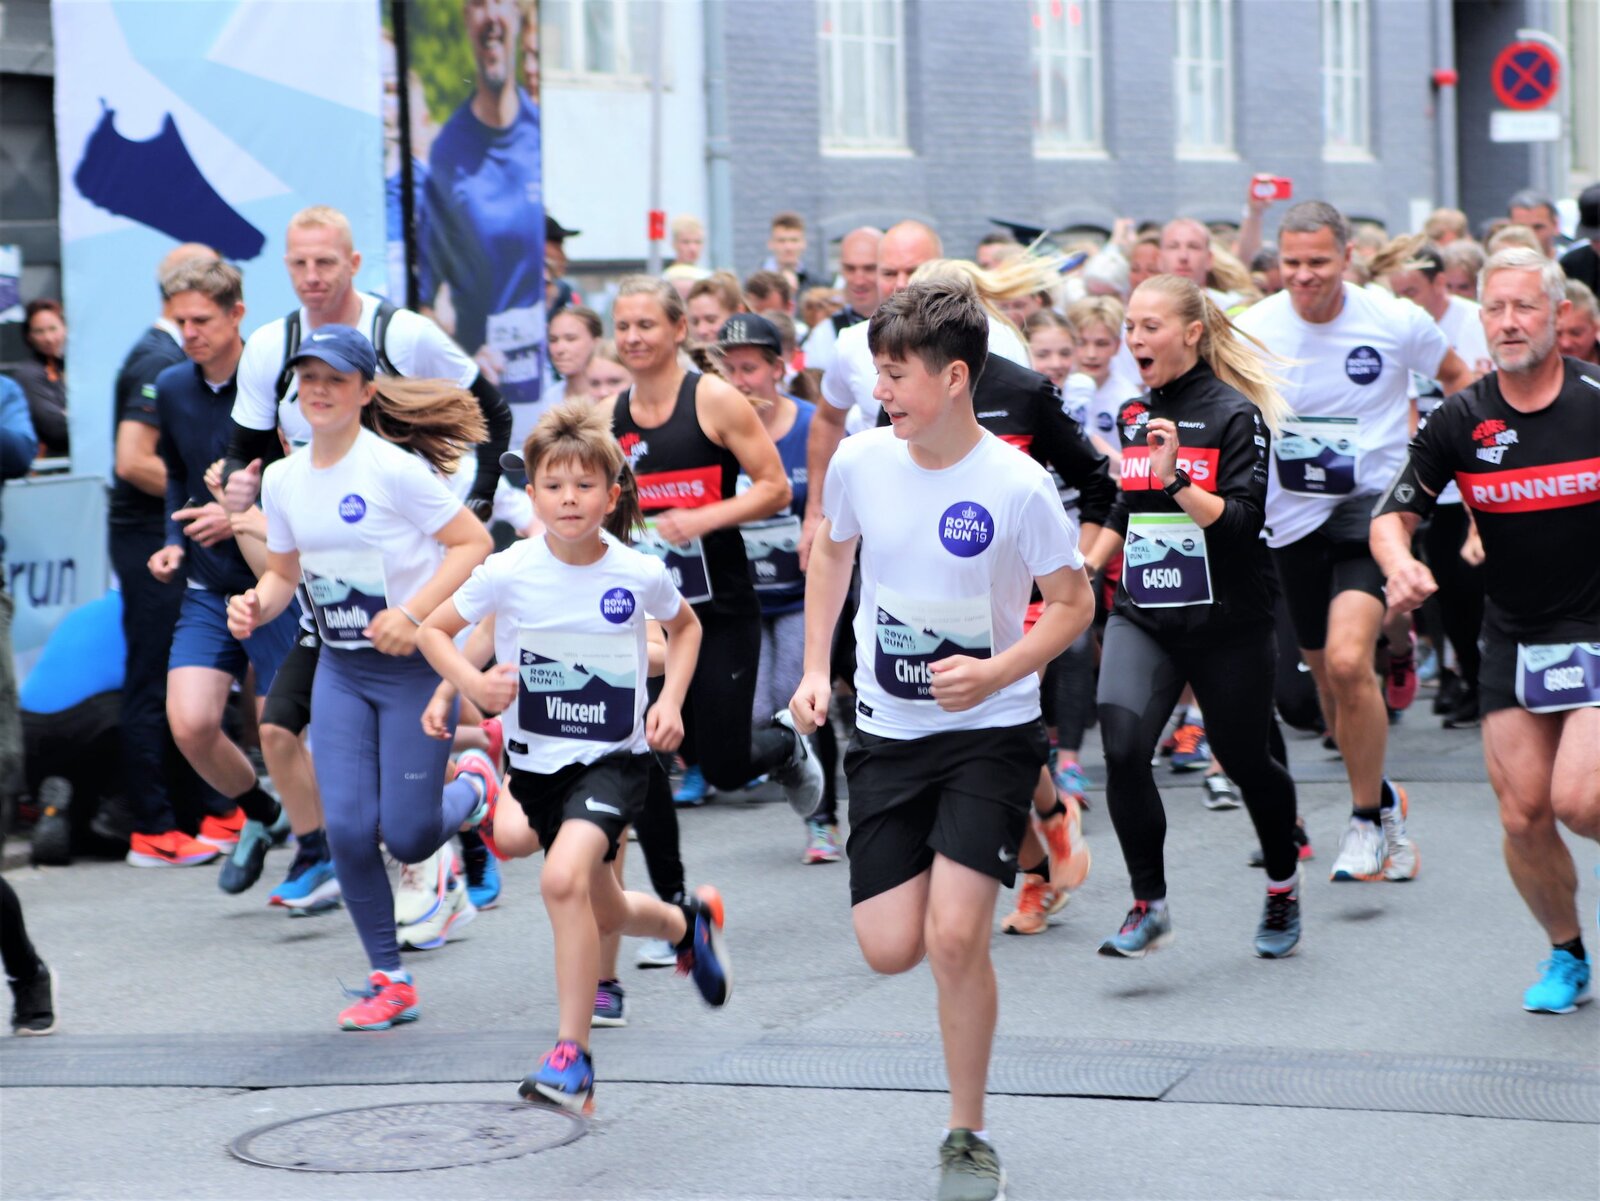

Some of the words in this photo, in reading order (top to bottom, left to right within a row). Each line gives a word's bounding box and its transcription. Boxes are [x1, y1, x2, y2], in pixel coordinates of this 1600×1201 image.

[1304, 463, 1326, 481] Jan
[638, 479, 705, 500] NNERS
[1471, 472, 1600, 504] RUNNER
[946, 516, 988, 533] ROYAL
[943, 527, 972, 542] RUN
[9, 557, 76, 608] run
[1142, 567, 1182, 589] 64500
[603, 598, 633, 607] ROYAL
[603, 606, 624, 614] RUN
[323, 605, 368, 629] Isabella
[884, 628, 915, 642] ROYAL
[884, 637, 904, 649] RUN
[530, 667, 565, 679] ROYAL
[895, 658, 934, 684] Chris
[529, 677, 552, 685] RUN
[545, 695, 606, 724] Vincent
[560, 724, 588, 735] 50004
